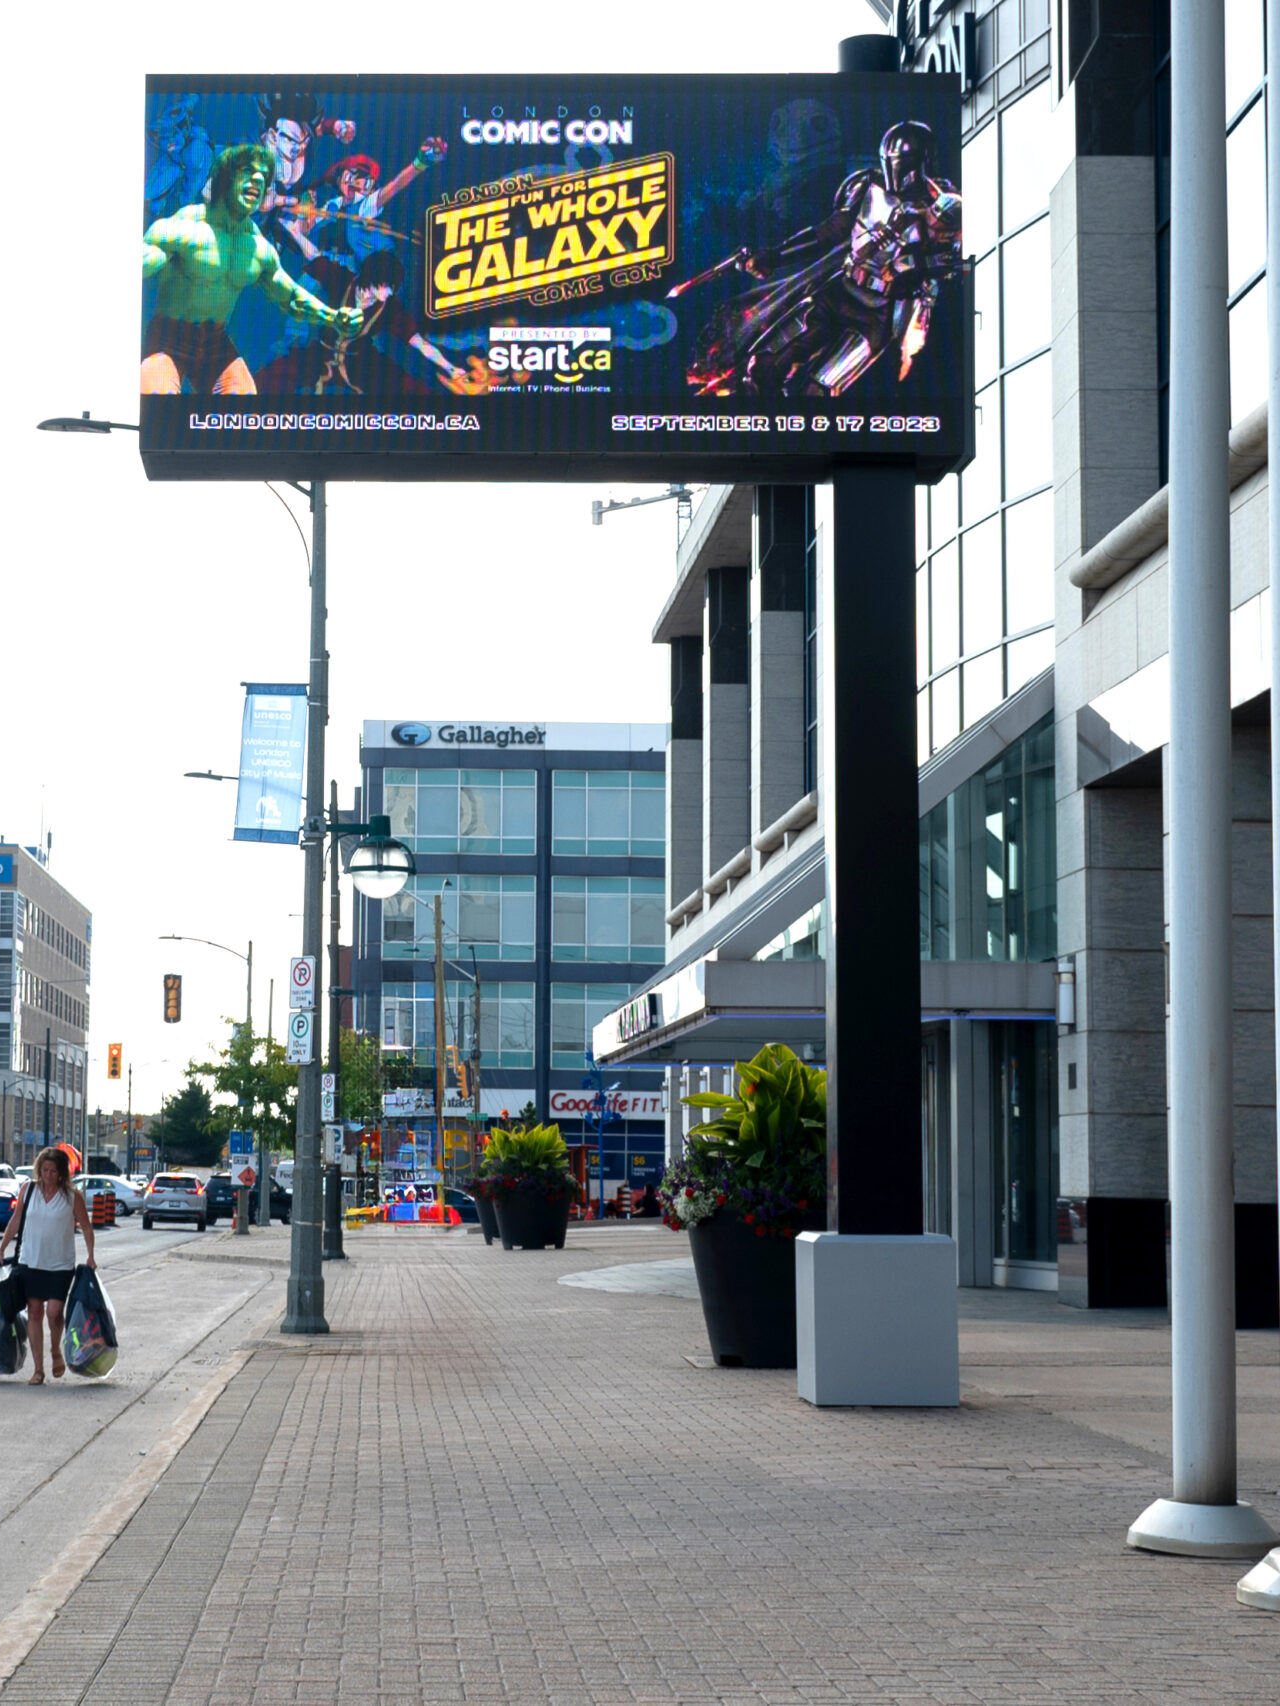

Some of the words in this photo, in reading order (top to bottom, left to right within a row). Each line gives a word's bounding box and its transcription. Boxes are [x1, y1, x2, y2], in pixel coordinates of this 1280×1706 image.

[462, 105, 634, 118] LONDON
[461, 119, 561, 145] COMIC
[565, 119, 634, 145] CON
[441, 172, 535, 207] LONDON
[510, 189, 544, 208] FUN
[550, 180, 587, 198] FOR
[436, 200, 511, 250] THE
[527, 175, 666, 230] WHOLE
[433, 204, 666, 293] GALAXY
[527, 274, 604, 307] COMIC
[609, 261, 663, 287] CON
[502, 330, 578, 339] PRESENTED
[583, 330, 598, 339] BY
[487, 343, 612, 372] start.ca
[487, 384, 521, 393] Internet
[527, 385, 539, 393] TV
[543, 384, 570, 393] Phone
[575, 384, 611, 393] Business
[189, 413, 481, 431] LONDONCOMICCON.CA
[611, 414, 770, 432] SEPTEMBER
[775, 415, 805, 432] 16
[810, 415, 830, 432] &
[835, 415, 864, 432] 17
[869, 415, 941, 432] 2023
[253, 711, 292, 720] unesco
[243, 738, 288, 748] Welcome
[438, 725, 547, 748] Gallagher
[253, 748, 289, 757] London
[442, 1096, 474, 1108] ntact
[551, 1092, 629, 1113] Goodife
[631, 1097, 666, 1113] FIT
